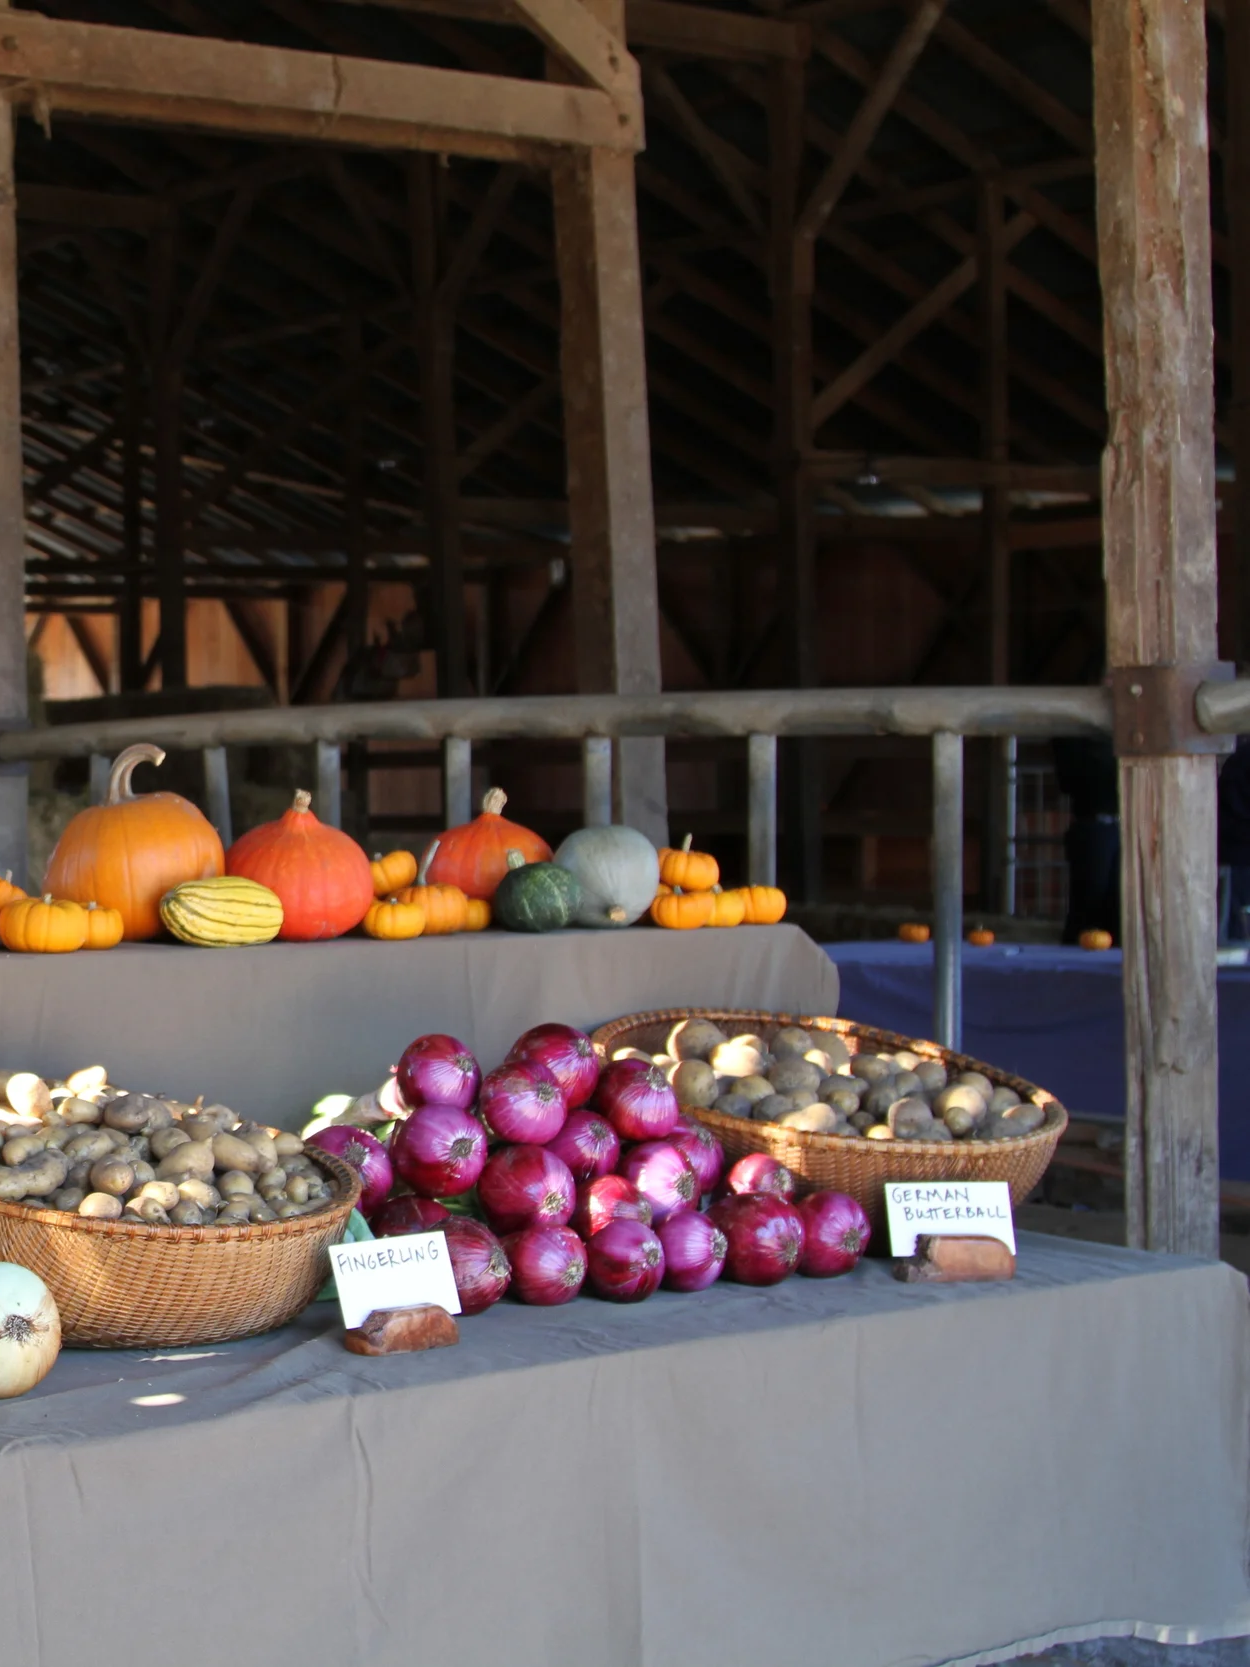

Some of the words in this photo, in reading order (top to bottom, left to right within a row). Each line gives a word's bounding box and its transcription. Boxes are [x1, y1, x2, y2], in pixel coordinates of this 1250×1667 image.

[891, 1187, 970, 1204] GERMAN
[903, 1205, 1008, 1221] BUTTERBALL
[336, 1240, 439, 1275] FINGERLING
